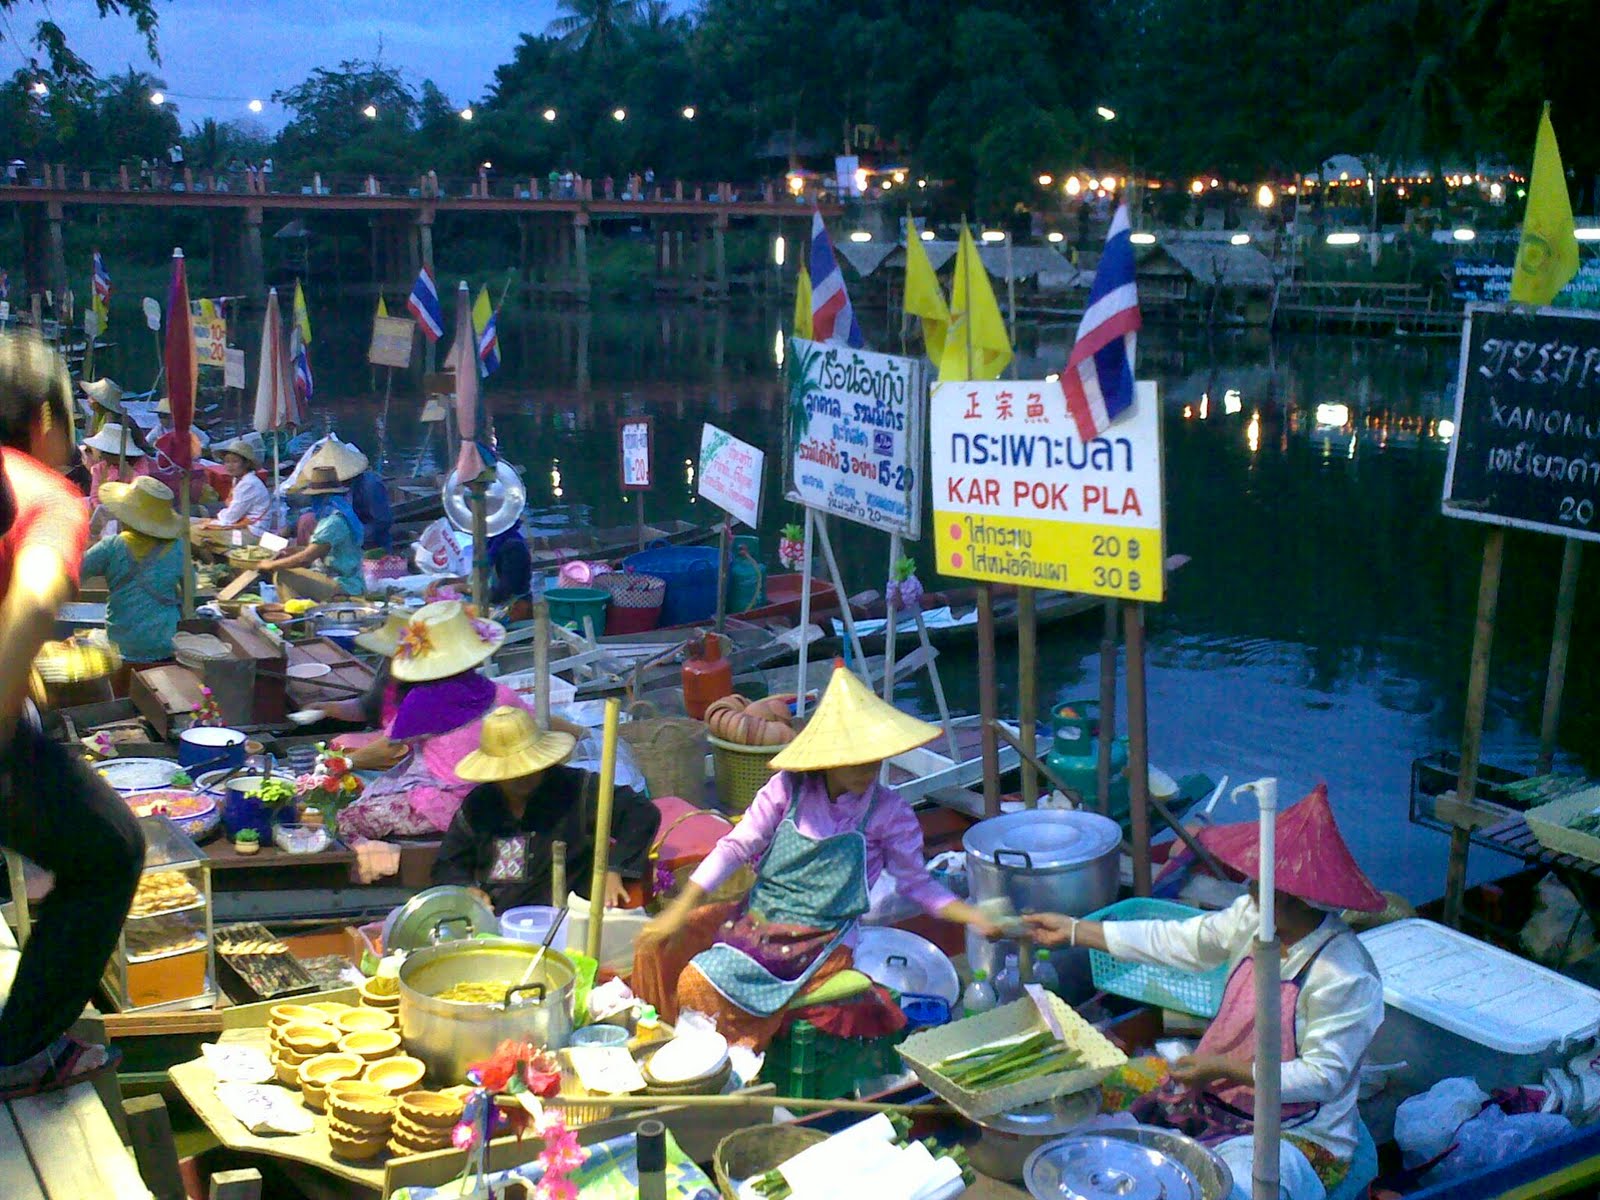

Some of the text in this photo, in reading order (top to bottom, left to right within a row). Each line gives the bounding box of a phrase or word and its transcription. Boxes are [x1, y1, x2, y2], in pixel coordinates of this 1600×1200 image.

[840, 451, 850, 474] 3
[948, 477, 1142, 517] KAR POK PLA
[1558, 496, 1594, 525] 20
[1092, 535, 1121, 558] 20
[1093, 566, 1122, 589] 30
